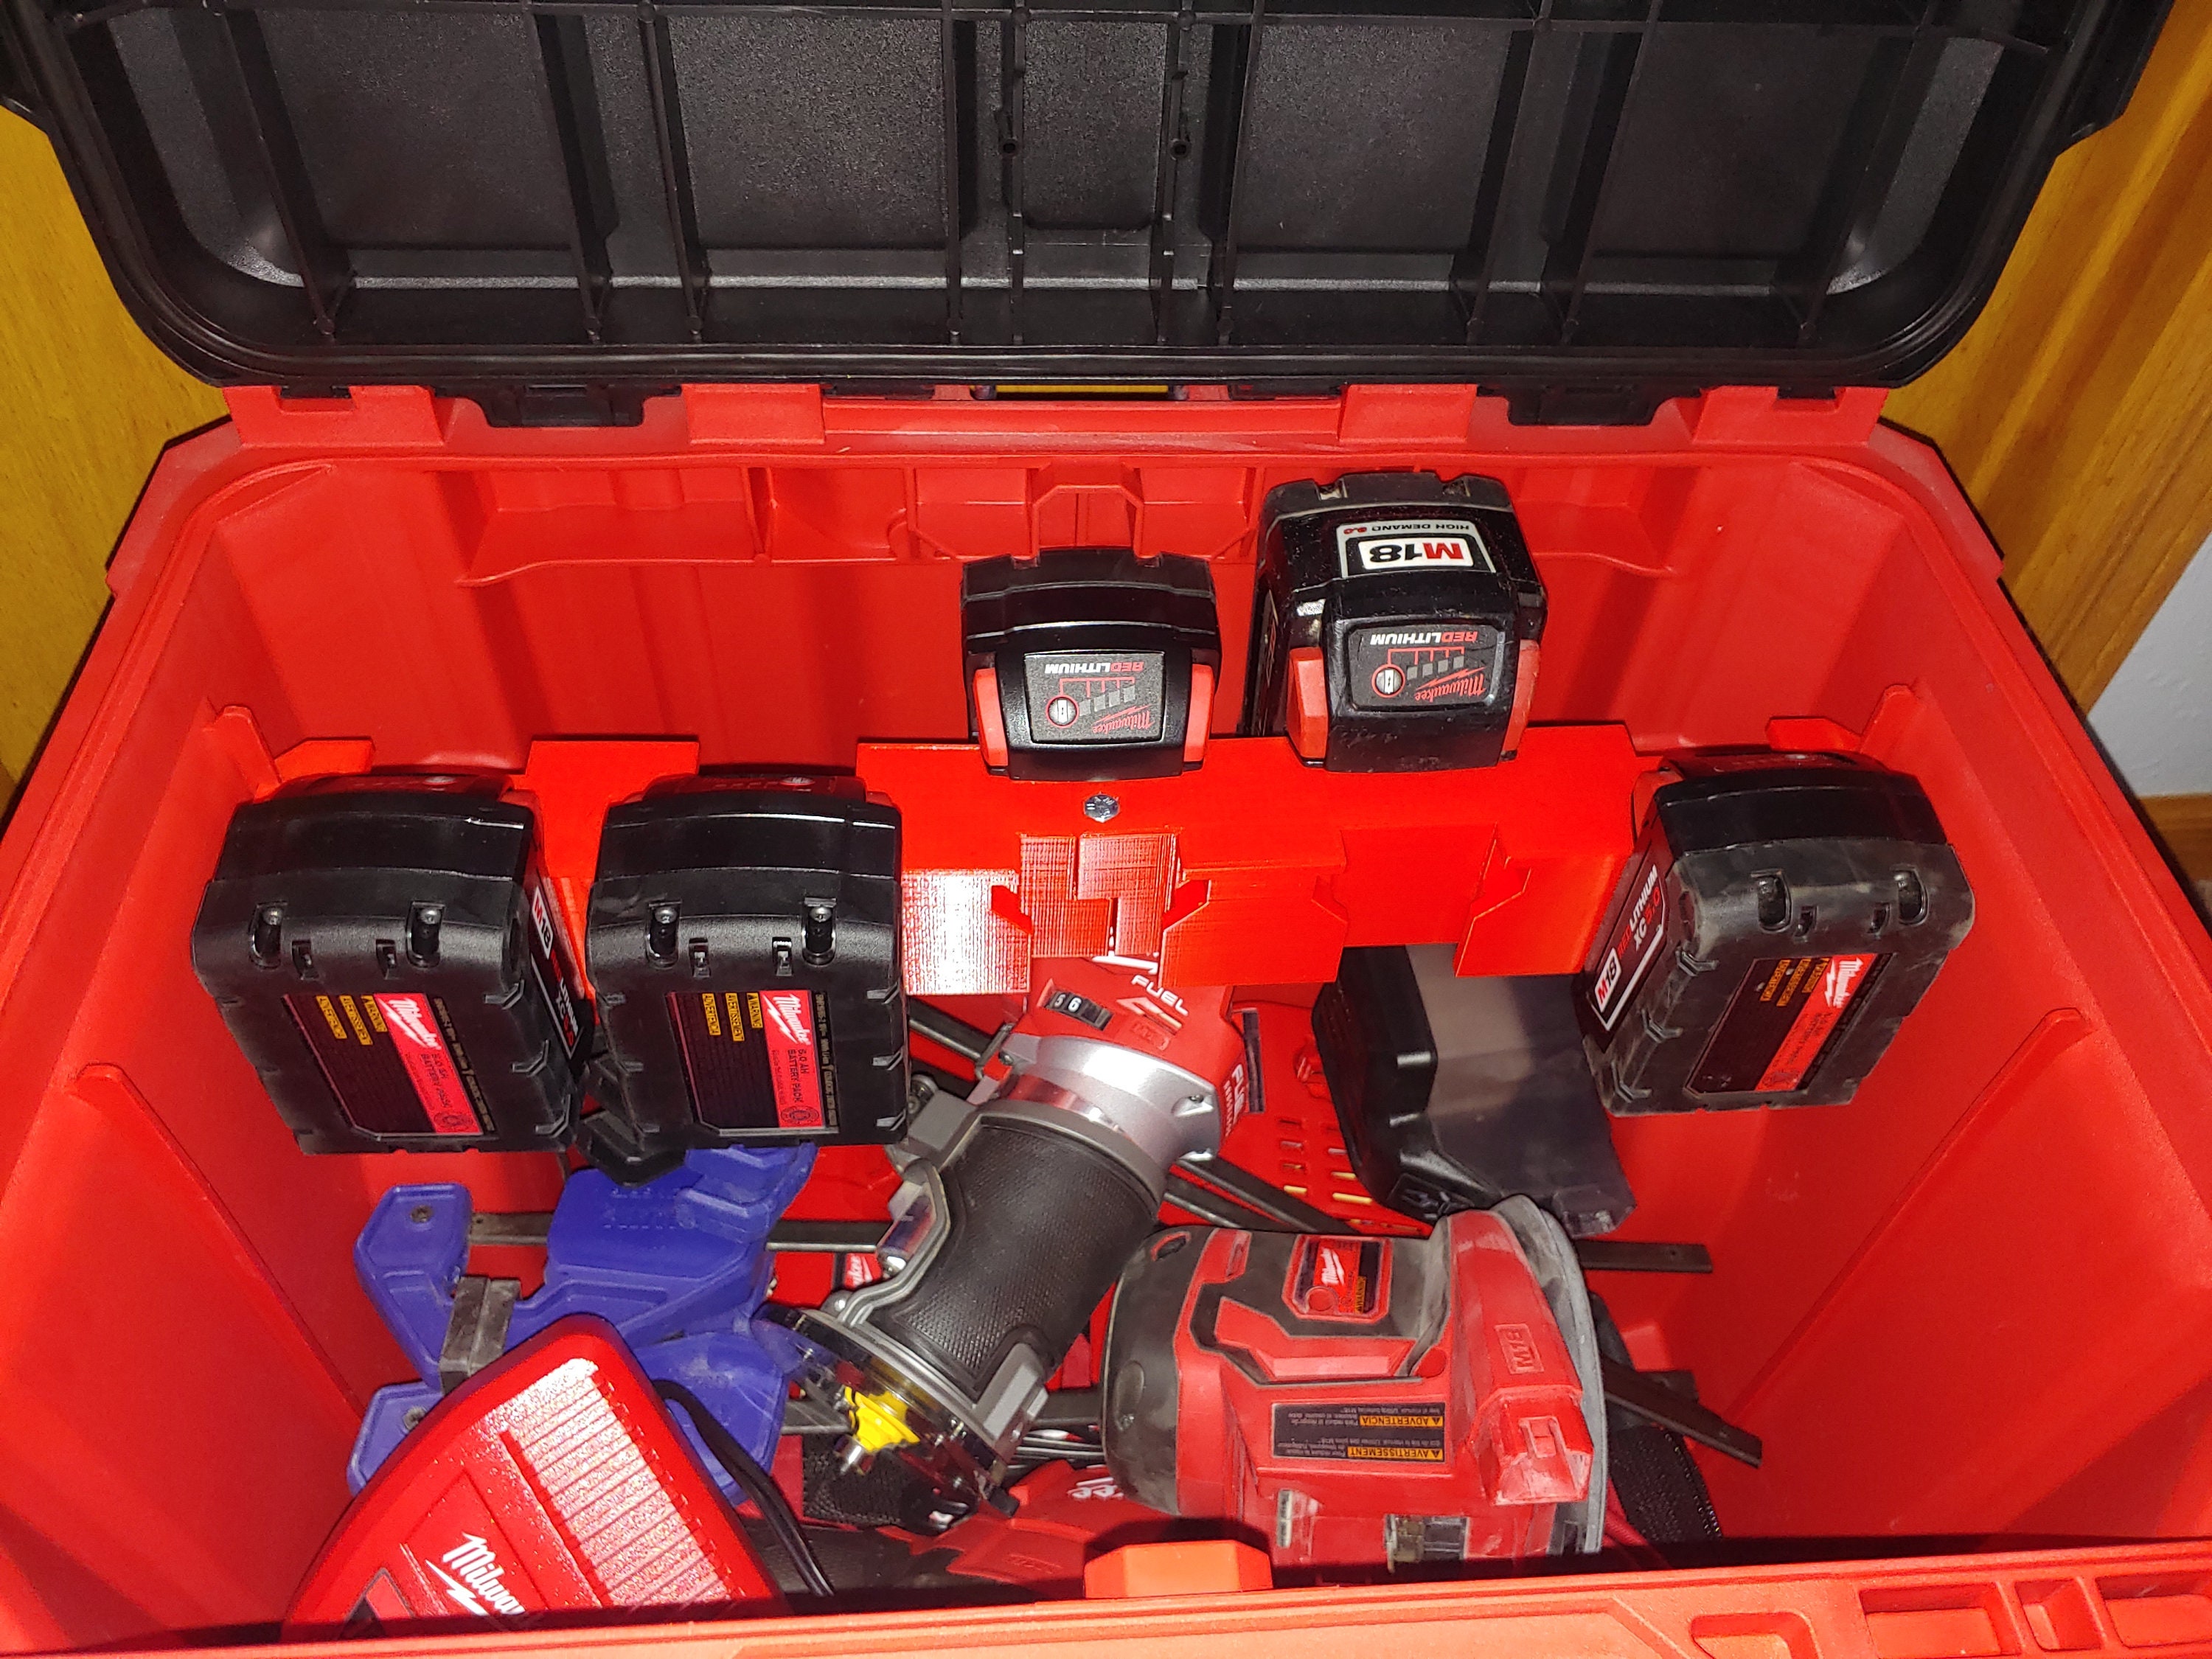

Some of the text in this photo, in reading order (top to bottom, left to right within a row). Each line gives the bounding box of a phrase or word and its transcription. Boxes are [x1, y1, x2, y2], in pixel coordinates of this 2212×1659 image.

[1369, 542, 1464, 563] M18
[1414, 672, 1486, 703] Milwaukee
[1092, 710, 1155, 734] Milwaukee
[535, 897, 551, 949] M18
[1131, 975, 1189, 1016] FUEL
[1597, 958, 1617, 1005] M18
[1833, 957, 1864, 1009] Milwaukee
[388, 998, 442, 1050] Milwaukee
[773, 994, 810, 1045] Milwaukee
[1068, 997, 1082, 1013] 6
[1361, 1416, 1428, 1426] ADVERTENCIA
[1350, 1447, 1428, 1458] AVERTISSEMENT
[442, 1531, 526, 1615] Milwa
